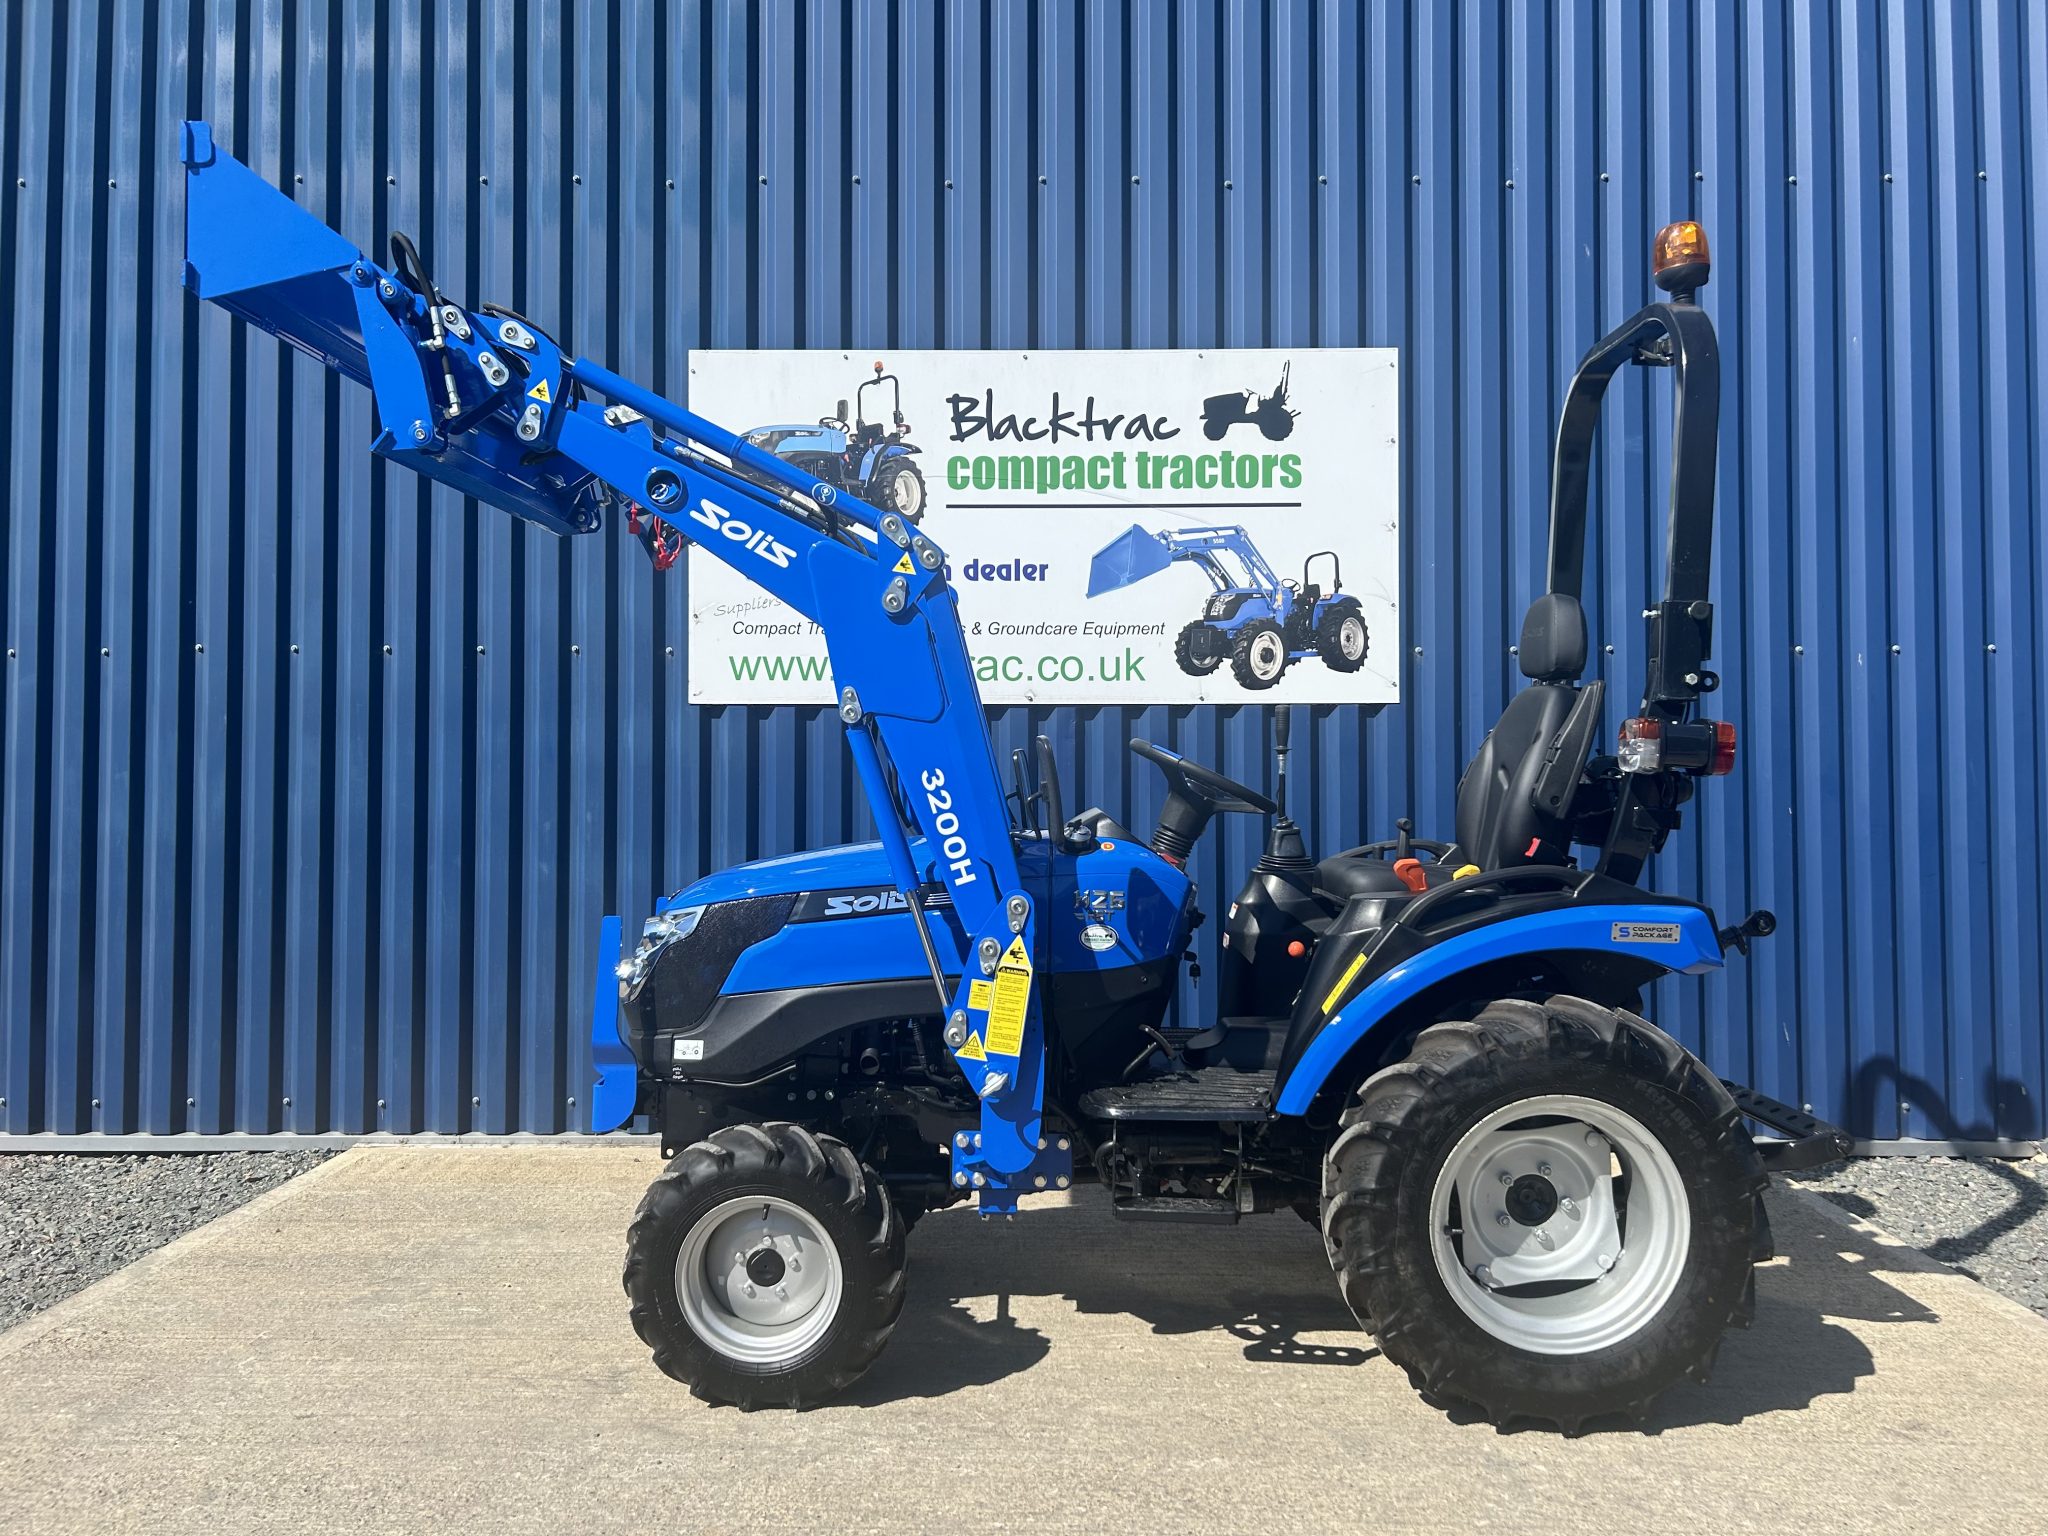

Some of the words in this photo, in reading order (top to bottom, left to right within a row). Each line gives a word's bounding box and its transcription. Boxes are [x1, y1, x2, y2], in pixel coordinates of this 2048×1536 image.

[945, 388, 1181, 445] Blacktrac
[946, 451, 1127, 494] compact
[1135, 450, 1302, 490] tractors
[963, 558, 1049, 582] dealer
[713, 596, 782, 618] Suppliers
[732, 621, 802, 638] Compact
[971, 621, 983, 635] &
[988, 621, 1078, 635] Groundcare
[1082, 621, 1166, 639] Equipment
[921, 767, 977, 887] 3200H
